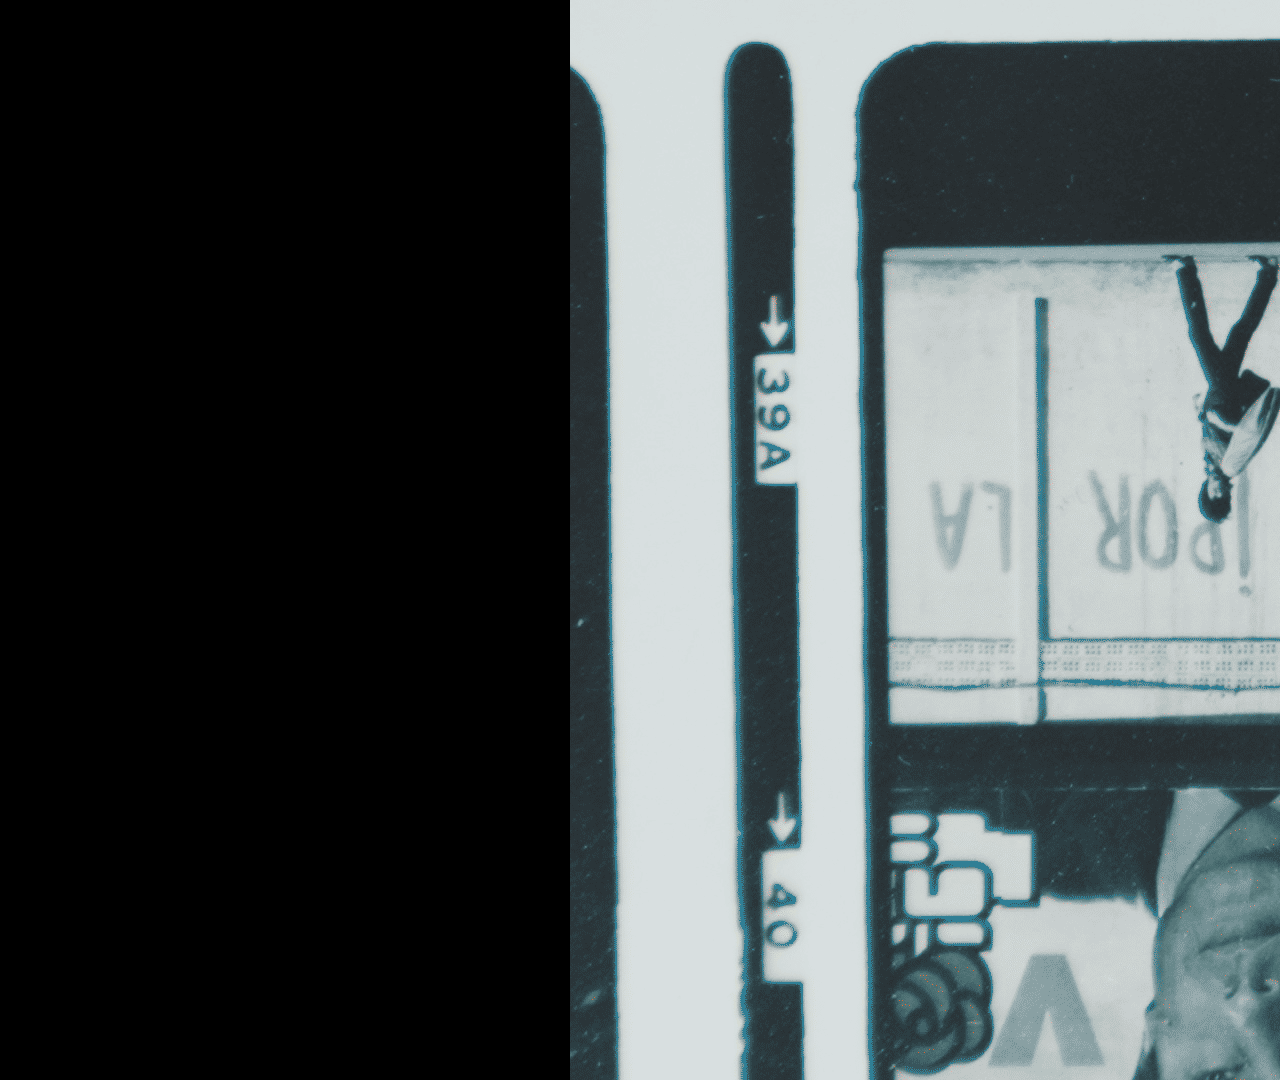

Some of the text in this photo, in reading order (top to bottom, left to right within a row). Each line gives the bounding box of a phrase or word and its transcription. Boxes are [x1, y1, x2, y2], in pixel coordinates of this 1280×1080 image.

[755, 366, 793, 473] 39A
[929, 480, 1013, 572] LA
[766, 881, 800, 950] 40
